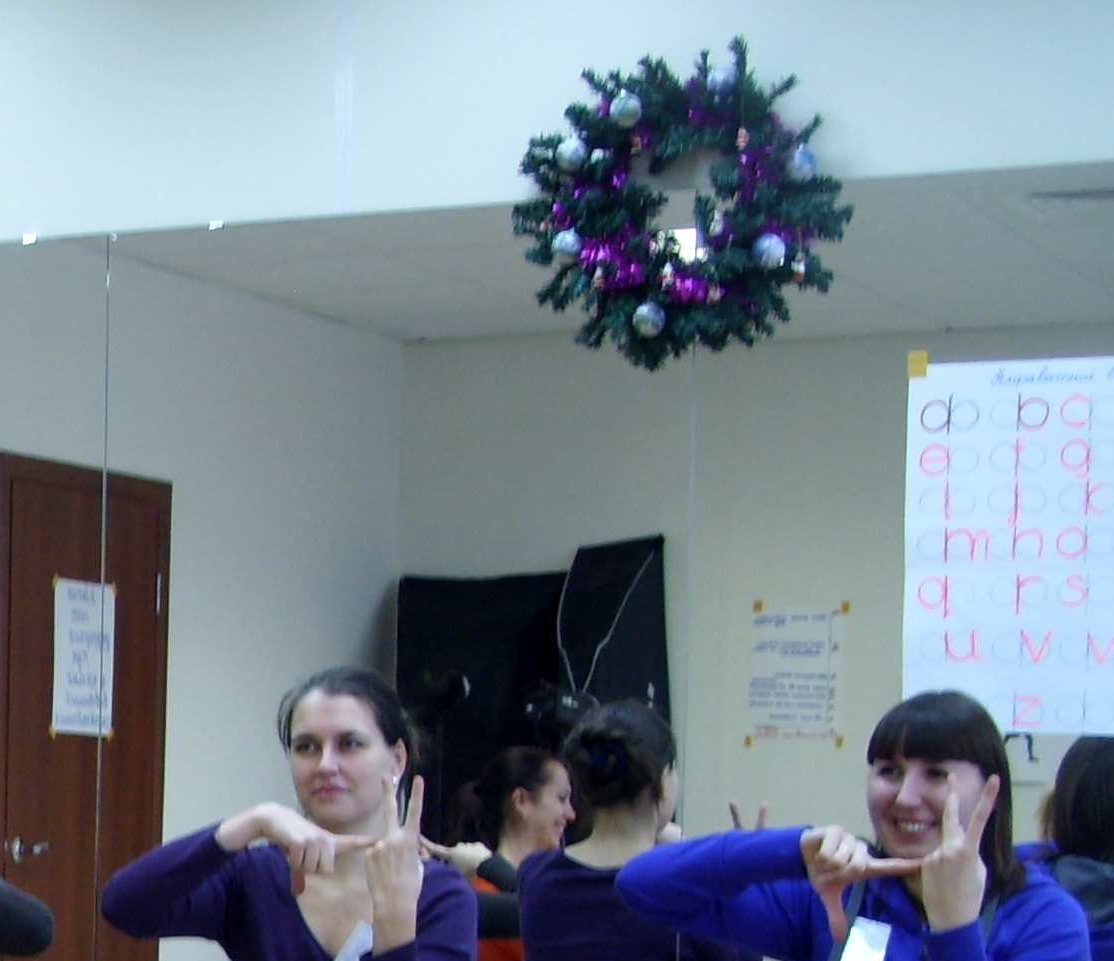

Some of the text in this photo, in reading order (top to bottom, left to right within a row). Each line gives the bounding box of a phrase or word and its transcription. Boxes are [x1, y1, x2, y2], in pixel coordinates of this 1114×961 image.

[1016, 392, 1050, 432] b
[1061, 394, 1092, 430] c
[919, 443, 950, 477] e
[1083, 478, 1104, 516] k
[942, 528, 990, 563] m
[1015, 574, 1042, 615] r
[1061, 573, 1089, 608] s
[944, 629, 983, 663] u
[1020, 629, 1054, 664] v
[1012, 695, 1043, 729] z
